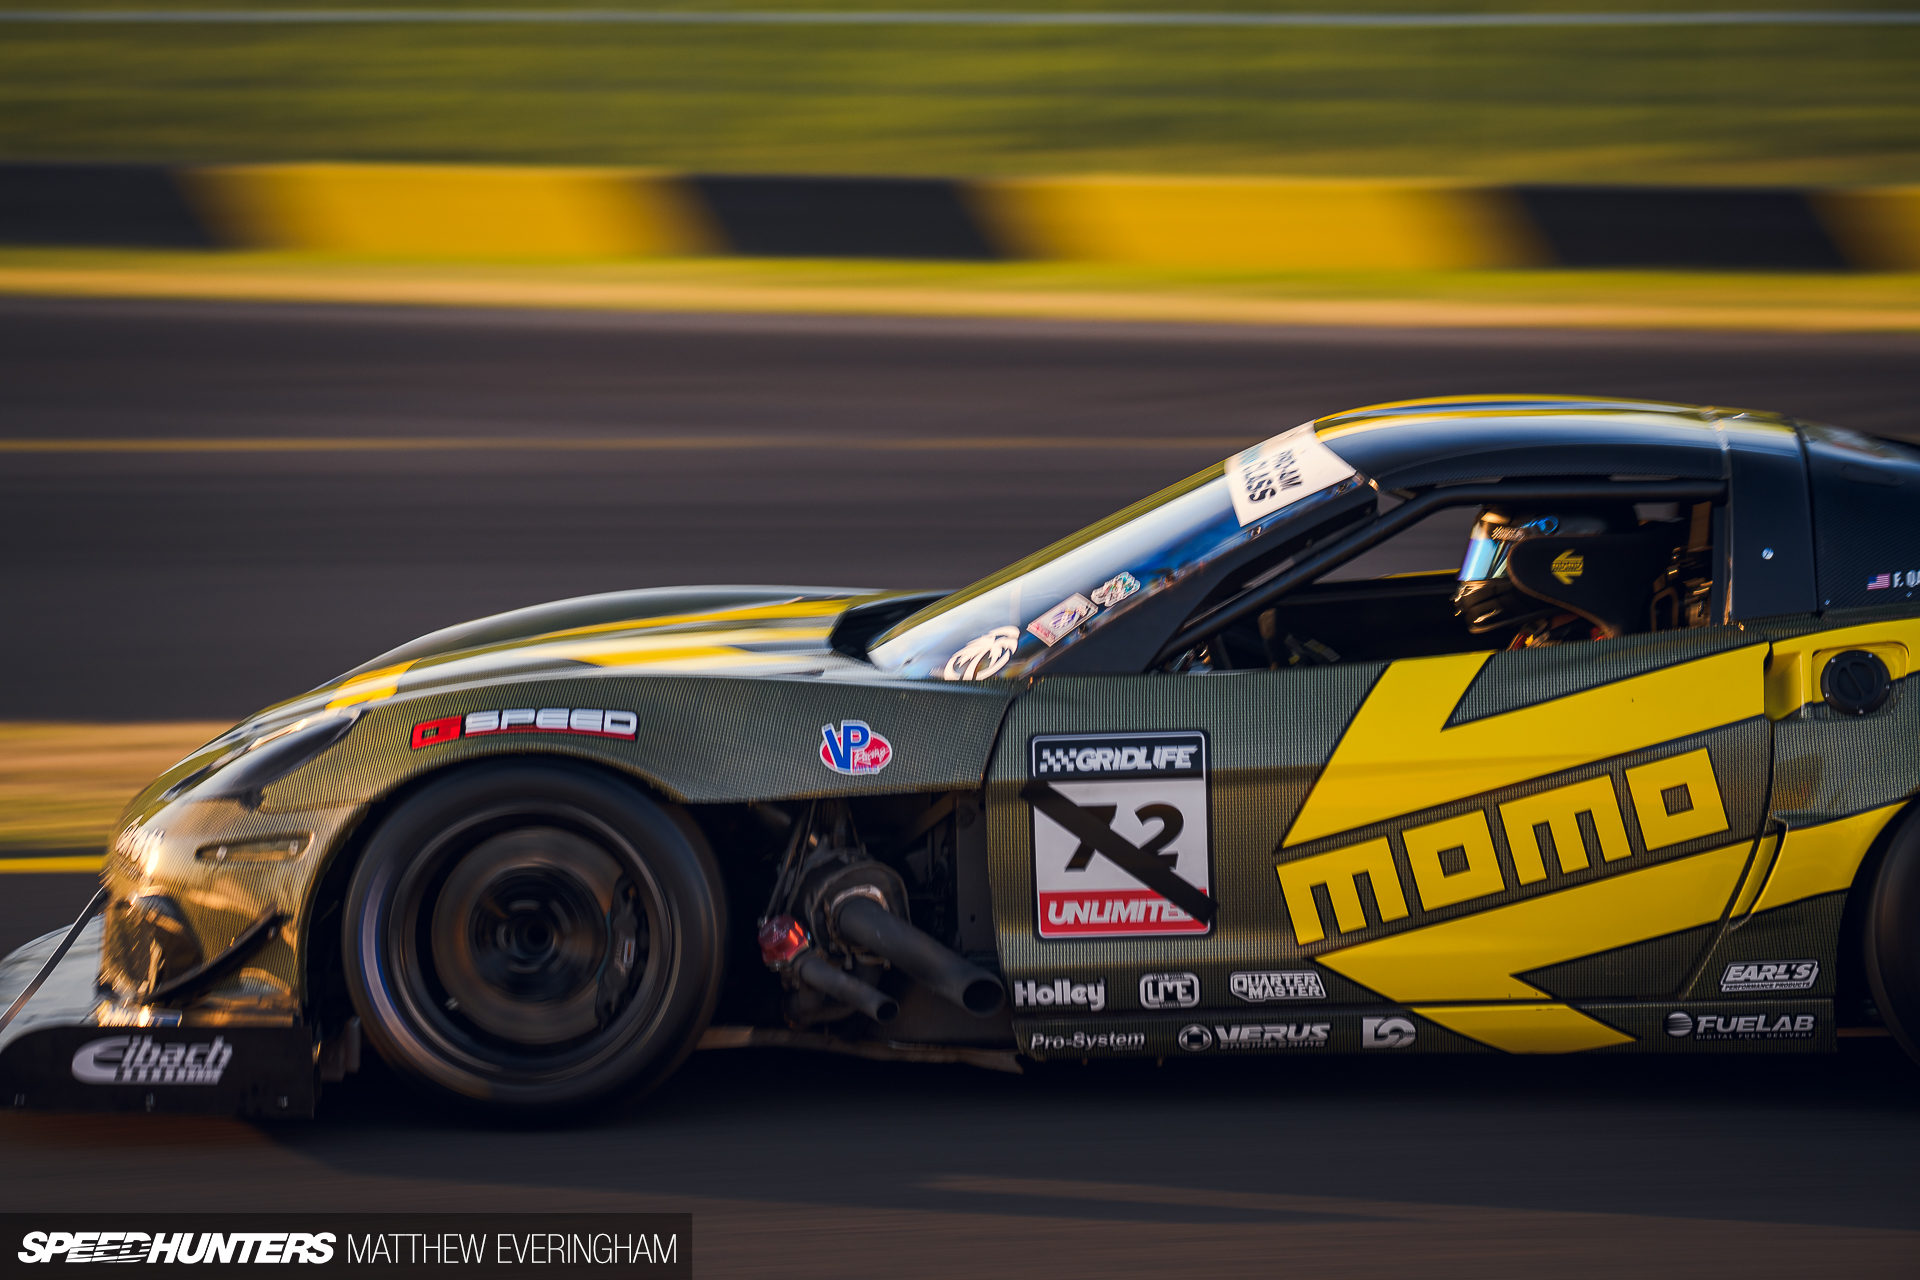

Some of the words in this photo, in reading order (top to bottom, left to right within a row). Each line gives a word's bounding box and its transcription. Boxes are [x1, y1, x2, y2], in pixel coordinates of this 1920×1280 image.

[822, 721, 870, 771] VP
[1075, 744, 1198, 772] GRIDLIFE
[1047, 898, 1195, 925] UNLIMITE
[1725, 963, 1813, 982] EARL'S
[1233, 973, 1317, 993] QUARTER
[1248, 985, 1321, 999] MASTER
[1014, 979, 1105, 1011] Holley
[1031, 1031, 1145, 1050] Pro-System
[1214, 1023, 1332, 1042] VERUS
